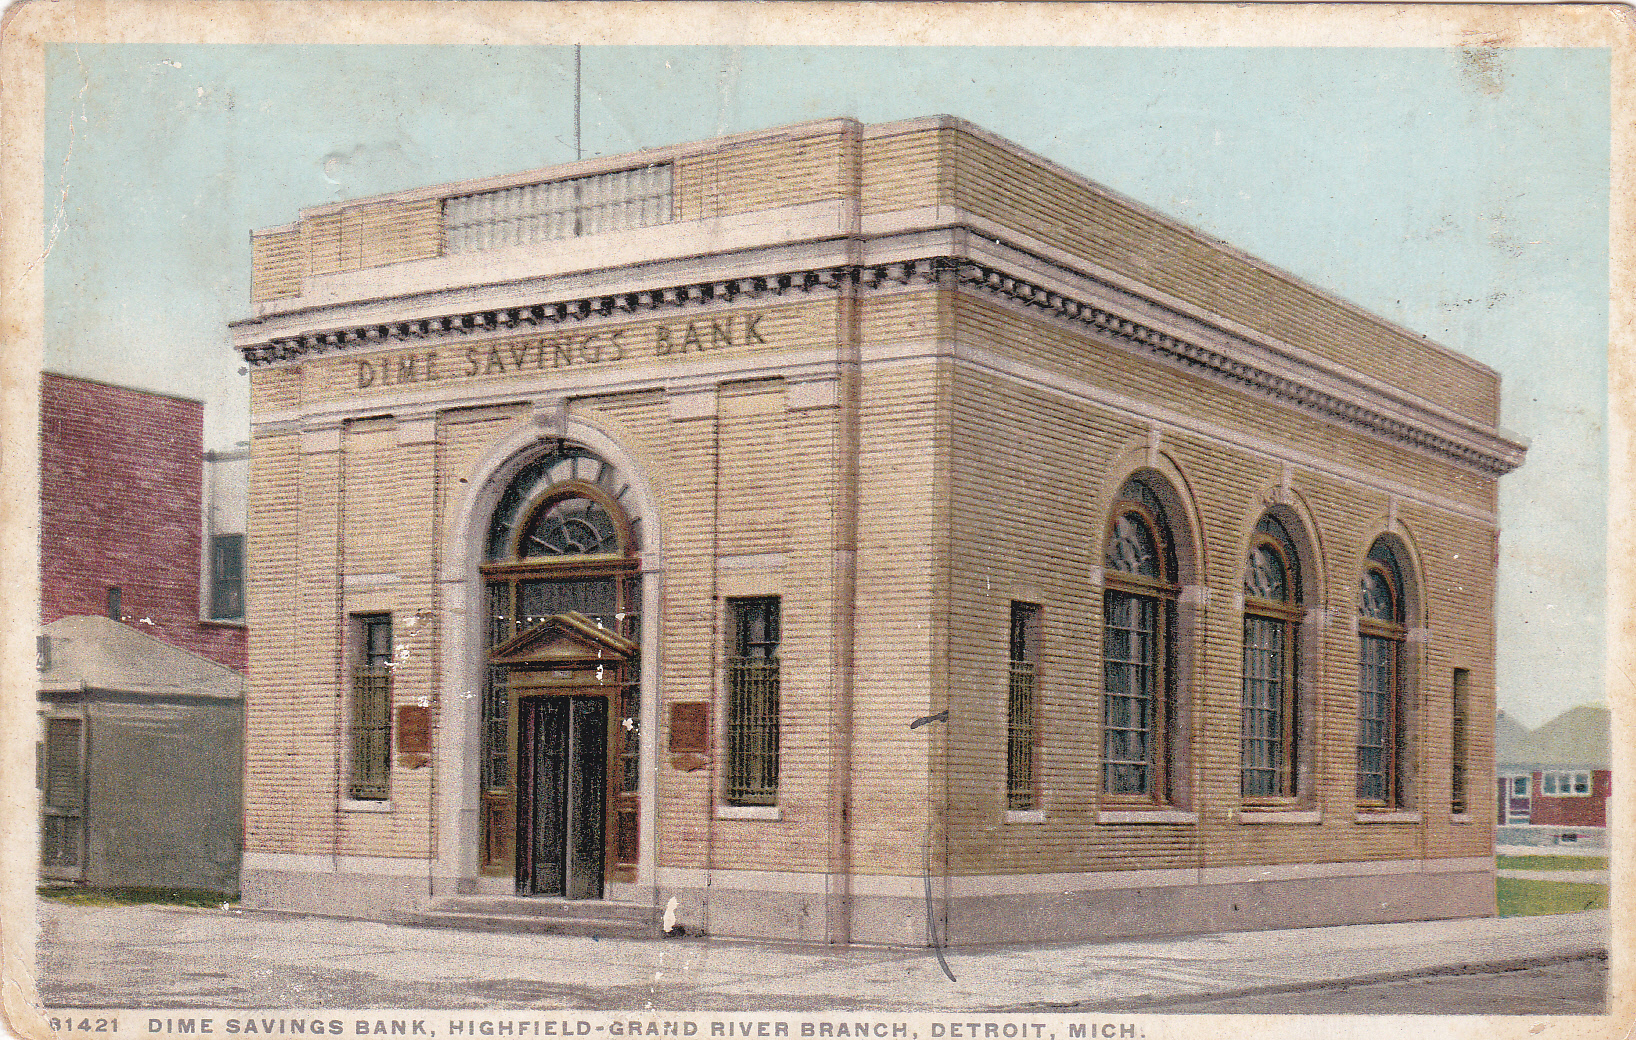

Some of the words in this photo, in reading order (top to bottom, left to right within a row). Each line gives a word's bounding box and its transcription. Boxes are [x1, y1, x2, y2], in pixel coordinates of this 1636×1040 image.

[357, 351, 439, 388] DIME
[465, 329, 628, 377] SAVINGS
[654, 314, 766, 356] BANK
